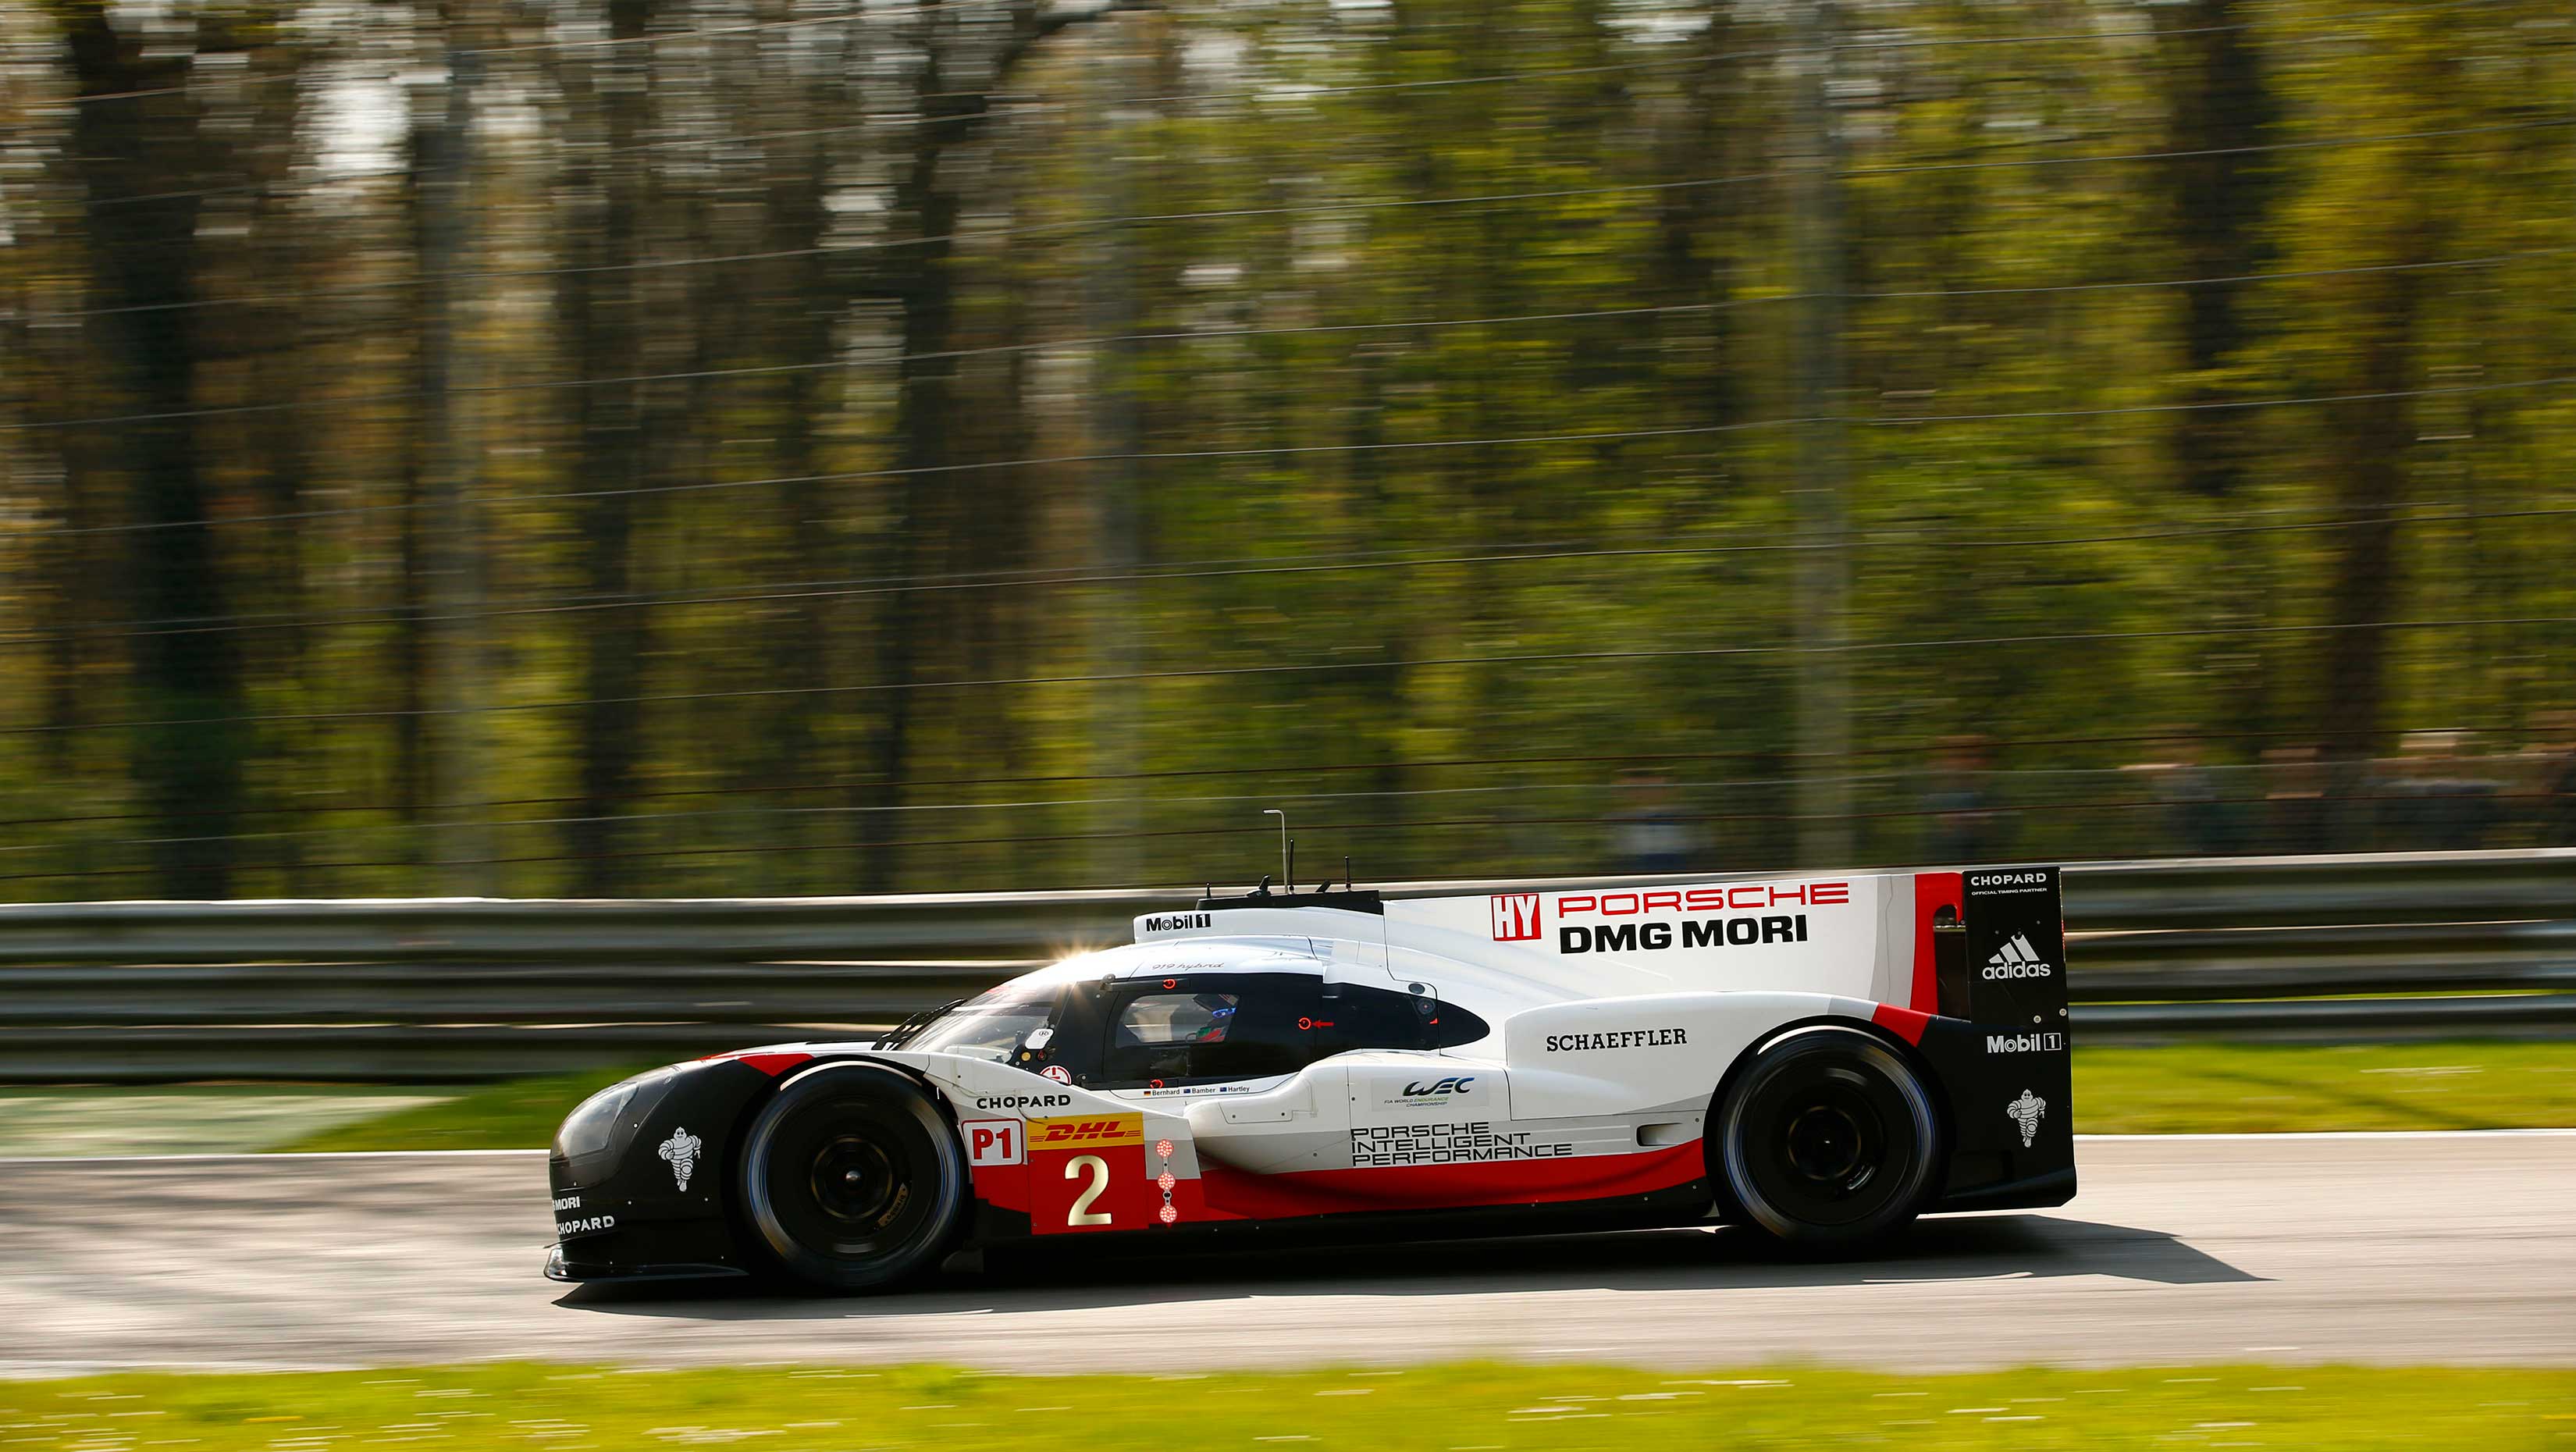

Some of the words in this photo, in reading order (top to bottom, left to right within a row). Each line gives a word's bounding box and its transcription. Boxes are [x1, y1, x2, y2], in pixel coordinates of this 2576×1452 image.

[1970, 873, 2047, 886] CHOPARD
[1558, 883, 1848, 918] PORSCHE
[1146, 914, 1193, 931] Mobil
[1493, 895, 1540, 938] HY
[1560, 924, 1672, 954] DMG
[1682, 914, 1808, 948] MORI
[1176, 962, 1225, 972] hybrid
[1982, 961, 2051, 980] adidas
[1546, 1028, 1688, 1052] SCHAEFFLER
[1987, 1033, 2041, 1053] Mobil
[1403, 1077, 1475, 1096] WEC
[977, 1094, 1071, 1109] CHOPARD
[1044, 1121, 1126, 1141] DHL
[1350, 1122, 1489, 1141] PORSCHE
[972, 1128, 1012, 1159] P1
[1351, 1133, 1530, 1154] INTELLIGENT
[1352, 1144, 1572, 1166] PERFORMANCE
[1065, 1155, 1112, 1226] 2
